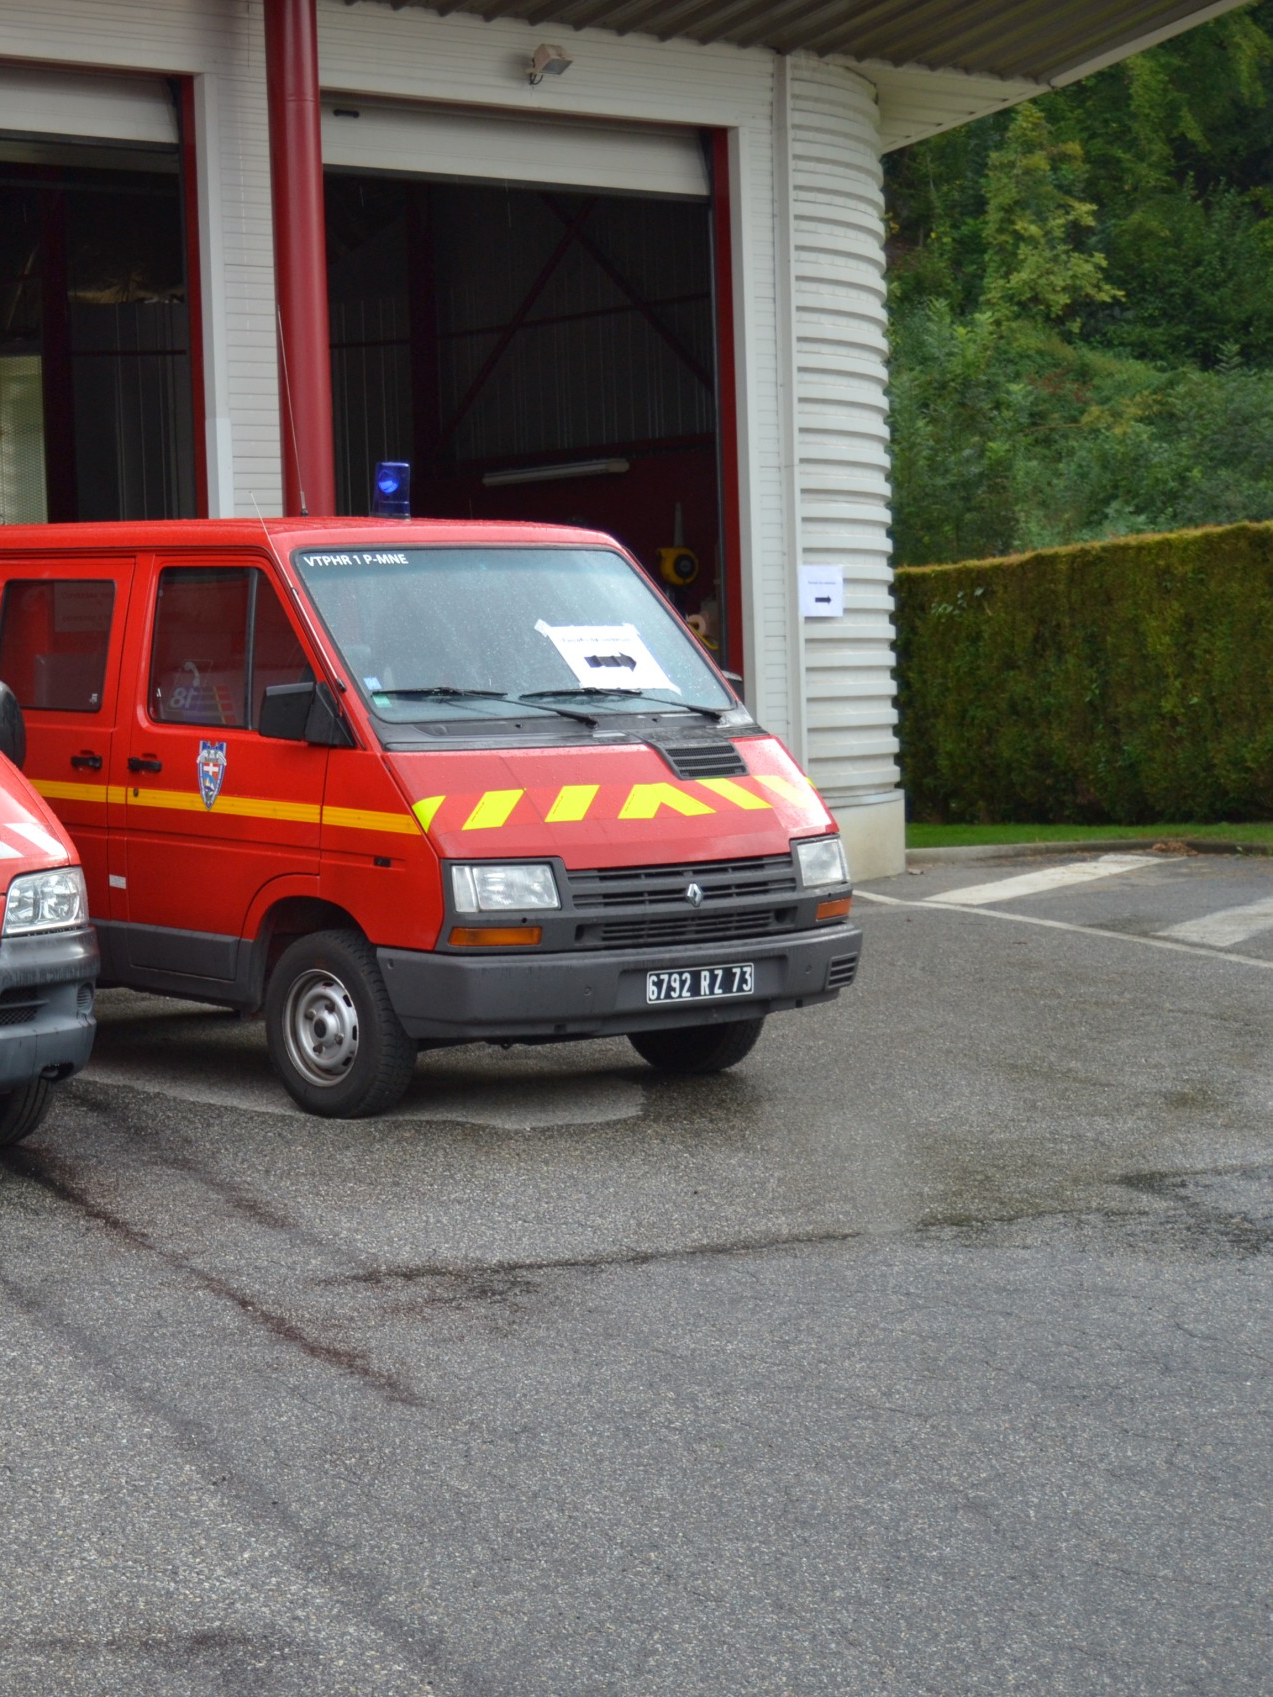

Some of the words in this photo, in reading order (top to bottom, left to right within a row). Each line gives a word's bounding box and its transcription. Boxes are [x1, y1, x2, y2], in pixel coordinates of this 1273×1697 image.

[303, 554, 353, 567] VTPHR
[352, 554, 362, 565] 1
[362, 553, 409, 565] P-MNE
[648, 972, 692, 1001] 6792
[700, 969, 723, 996] RZ
[732, 966, 752, 993] 73
